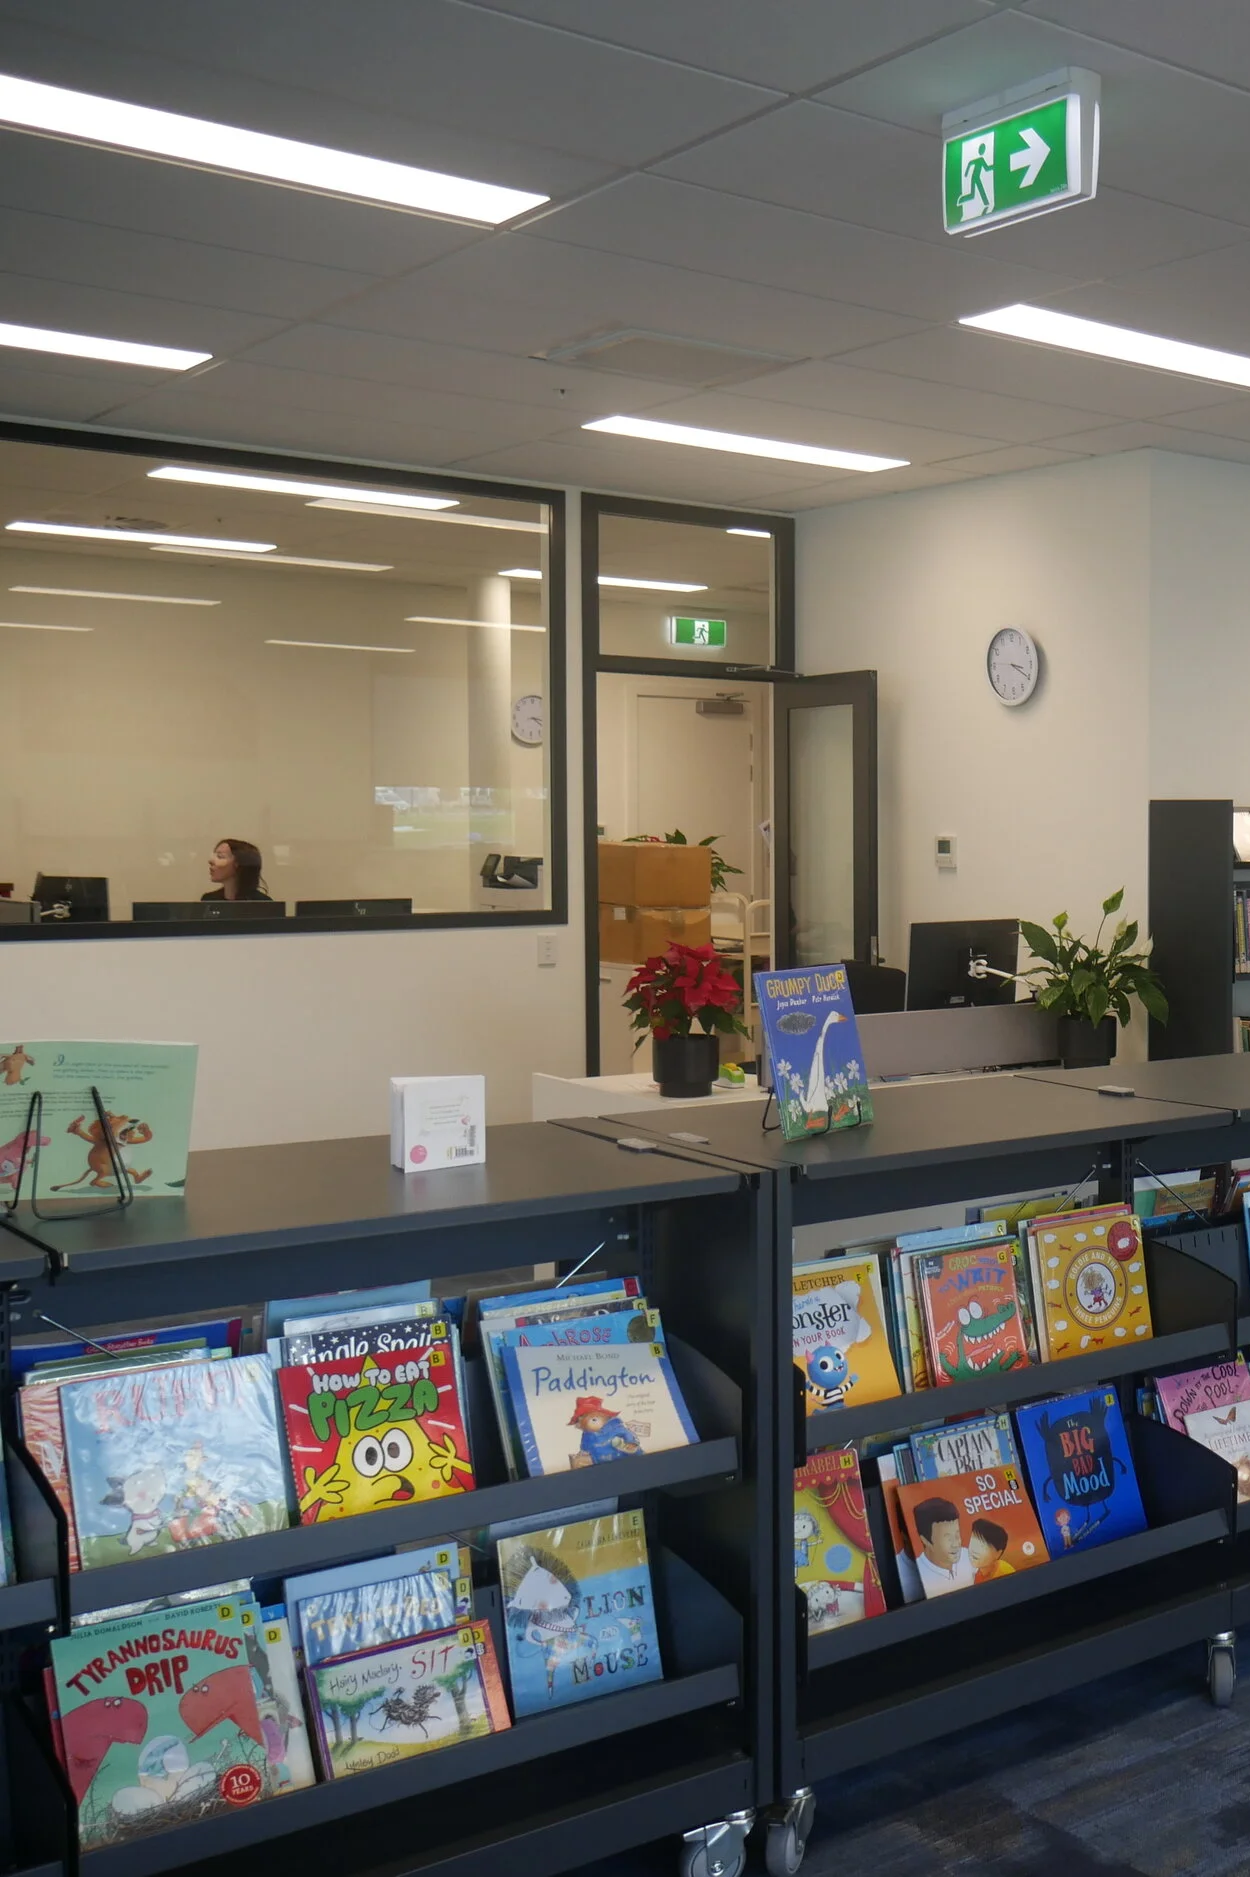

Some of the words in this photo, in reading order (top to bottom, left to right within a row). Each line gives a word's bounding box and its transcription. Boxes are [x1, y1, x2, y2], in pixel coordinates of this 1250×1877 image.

[766, 976, 811, 999] GRUMPY
[948, 1255, 977, 1271] CROC
[999, 1252, 1005, 1261] G
[1069, 1253, 1090, 1280] GOLDIE
[1091, 1251, 1105, 1260] AND
[1106, 1255, 1119, 1272] THE
[793, 1274, 845, 1292] LETCHER
[856, 1274, 862, 1282] F
[793, 1302, 852, 1330] onster
[1074, 1306, 1095, 1324] THREE
[1095, 1296, 1122, 1324] PENGUINS
[434, 1326, 442, 1336] B
[800, 1332, 823, 1345] YOUR
[825, 1327, 847, 1340] BOOK
[433, 1355, 440, 1364] B
[596, 1351, 620, 1360] BOND
[313, 1373, 361, 1395] HOW
[364, 1367, 391, 1386] TO
[394, 1359, 431, 1384] EAT
[531, 1366, 656, 1396] Paddington
[1173, 1388, 1197, 1424] DOWN
[1211, 1363, 1240, 1381] COOL
[1204, 1379, 1235, 1409] POOL
[307, 1379, 440, 1443] PIZZA
[937, 1428, 993, 1463] CAPTAIN
[1059, 1426, 1095, 1458] BIG
[844, 1457, 850, 1467] H
[1072, 1453, 1094, 1476] BAD
[976, 1474, 996, 1492] SO
[1006, 1471, 1013, 1479] H
[1063, 1457, 1111, 1500] Mood
[964, 1490, 1023, 1515] SPECIAL
[440, 1553, 448, 1564] D
[459, 1582, 466, 1593] D
[221, 1606, 230, 1618] D
[583, 1585, 646, 1620] LION
[94, 1620, 143, 1636] DONALDSON
[165, 1609, 189, 1621] DAVID
[241, 1613, 250, 1625] D
[268, 1630, 277, 1642] D
[463, 1632, 470, 1643] D
[65, 1628, 243, 1697] TYRANNOSAURUS
[329, 1667, 358, 1697] Hairy
[410, 1643, 458, 1680] SIT
[573, 1642, 649, 1685] MOUSE
[125, 1654, 189, 1697] DRIP
[344, 1756, 374, 1774] Lynley
[377, 1745, 400, 1765] Dodd
[230, 1773, 251, 1789] 10
